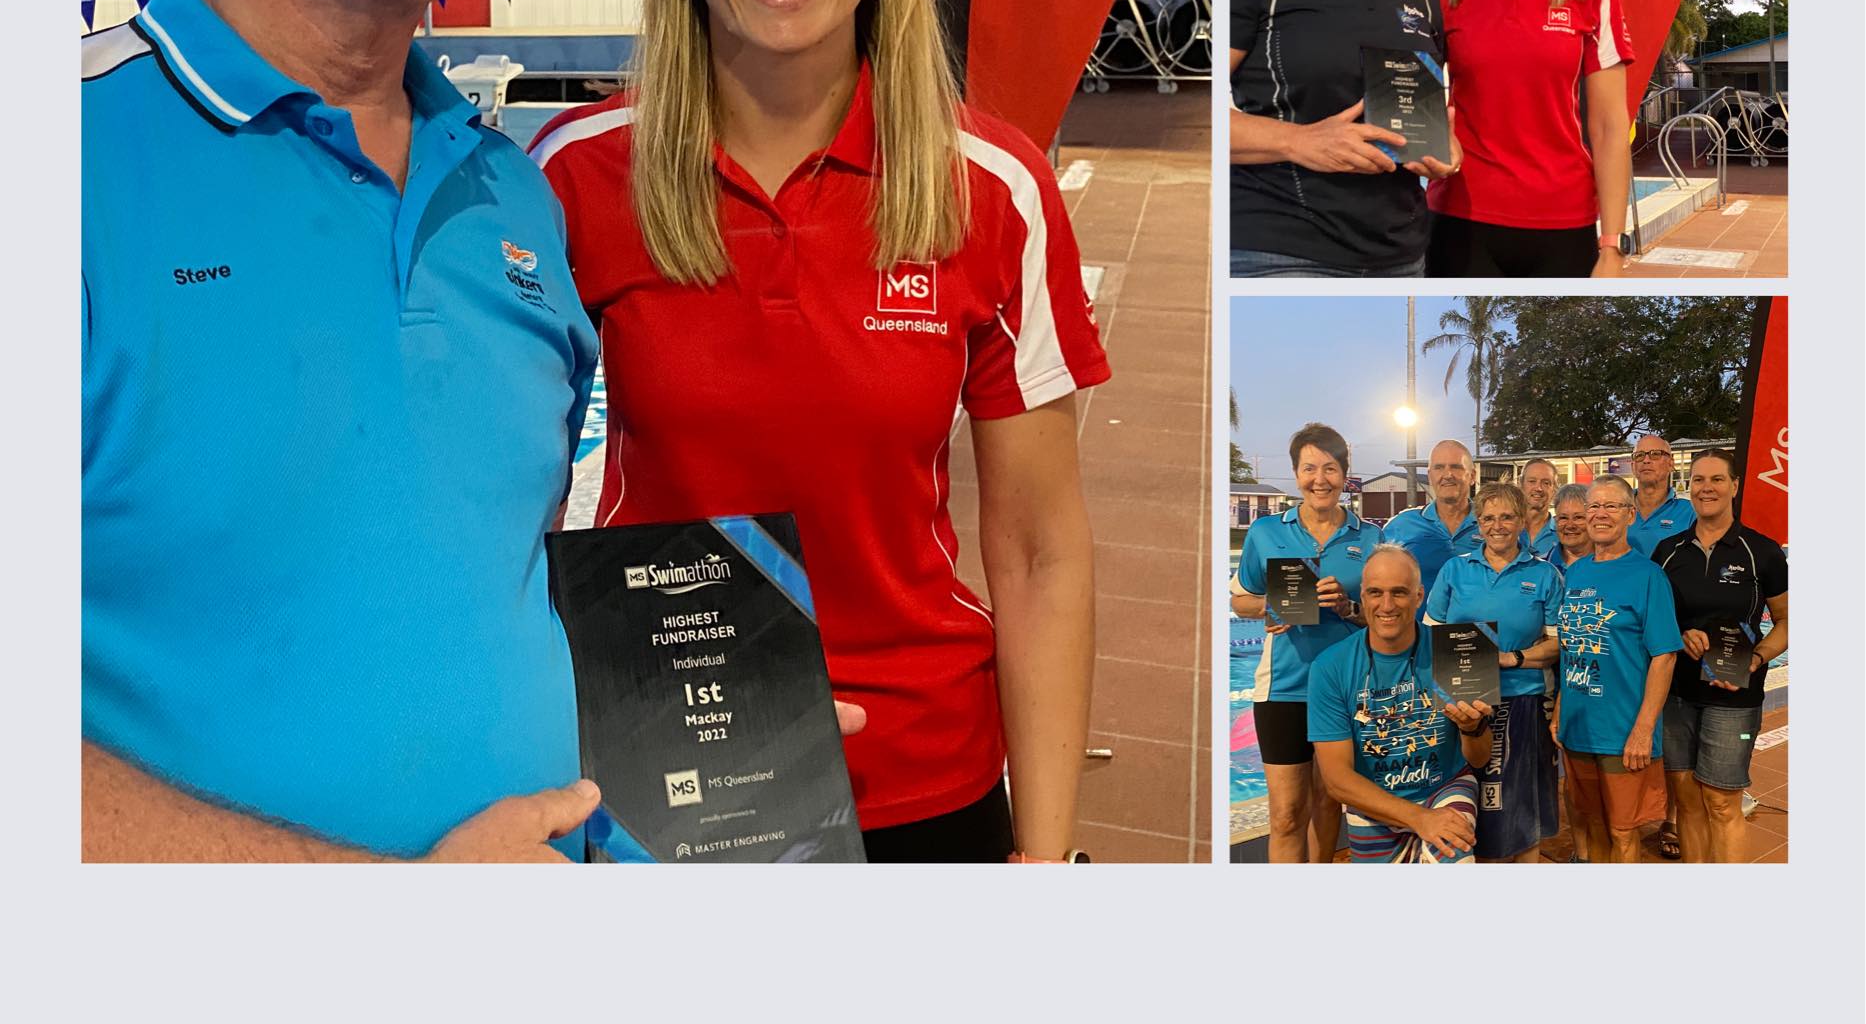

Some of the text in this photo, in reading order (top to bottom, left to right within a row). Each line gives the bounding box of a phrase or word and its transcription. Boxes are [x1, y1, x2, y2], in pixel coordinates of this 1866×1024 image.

[1551, 11, 1568, 21] MS
[1398, 95, 1412, 104] 3rd
[173, 265, 232, 286] Steve
[886, 273, 930, 299] MS
[863, 316, 948, 335] Queensland
[629, 559, 731, 586] MS Swimathon
[662, 611, 720, 629] HIGHEST
[651, 625, 737, 646] FUNDRAISER
[672, 652, 726, 670] Individual
[684, 681, 724, 707] 1st
[684, 711, 733, 727] Mackay
[696, 727, 728, 743] 2022
[671, 769, 774, 797] MS MS Queensland
[1384, 761, 1429, 790] splash
[1486, 787, 1496, 807] MS
[695, 831, 786, 854] MASTER ENGRAVING
